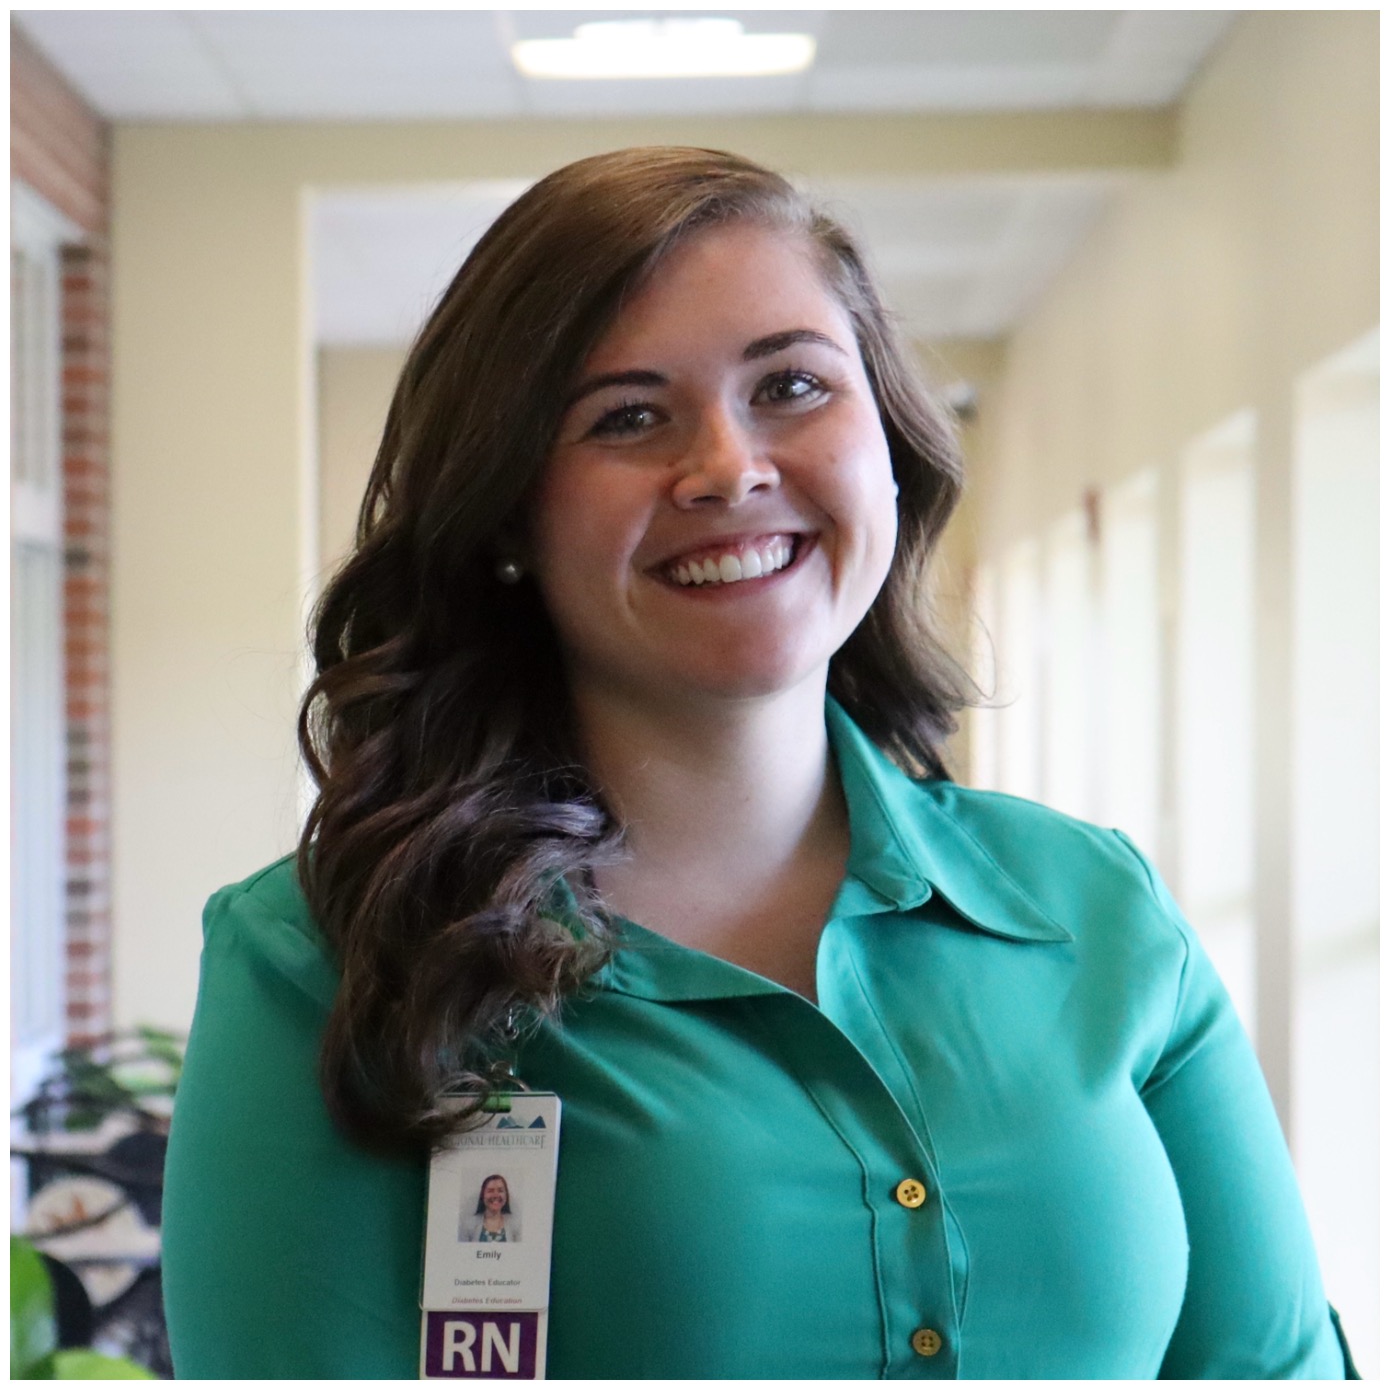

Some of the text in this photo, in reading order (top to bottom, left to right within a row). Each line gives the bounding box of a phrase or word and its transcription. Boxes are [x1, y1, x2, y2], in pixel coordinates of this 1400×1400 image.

[476, 1250, 501, 1260] Emily
[487, 1279, 521, 1287] Educator
[442, 1320, 521, 1373] RN
